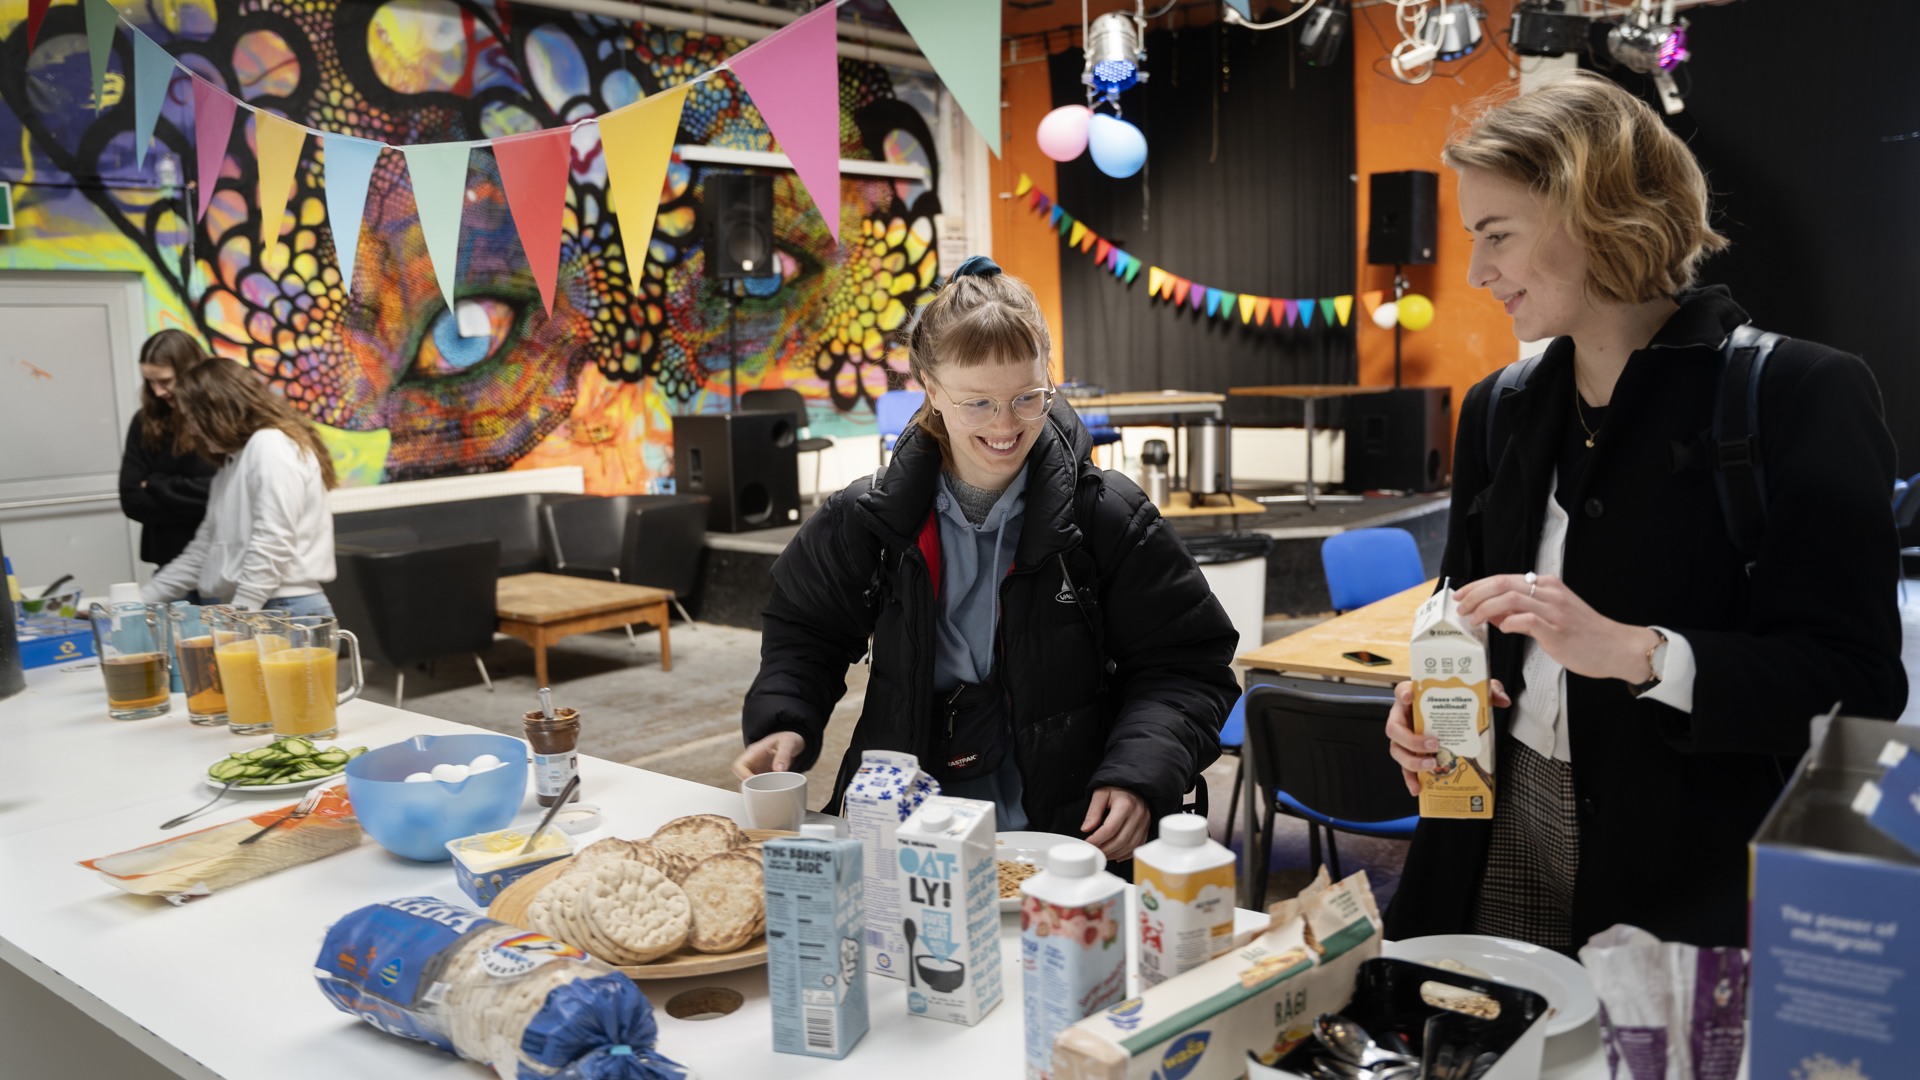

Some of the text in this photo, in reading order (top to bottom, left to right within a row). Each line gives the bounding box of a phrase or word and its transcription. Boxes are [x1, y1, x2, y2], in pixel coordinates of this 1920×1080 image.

[1451, 695, 1473, 703] vilken
[948, 754, 977, 767] EASTPAK
[764, 846, 831, 862] THE BORING
[899, 847, 959, 880] OAT-
[796, 861, 823, 874] SIDE
[909, 876, 952, 908] LY!
[1780, 904, 1898, 938] The power of
[1790, 928, 1884, 955] multigrain
